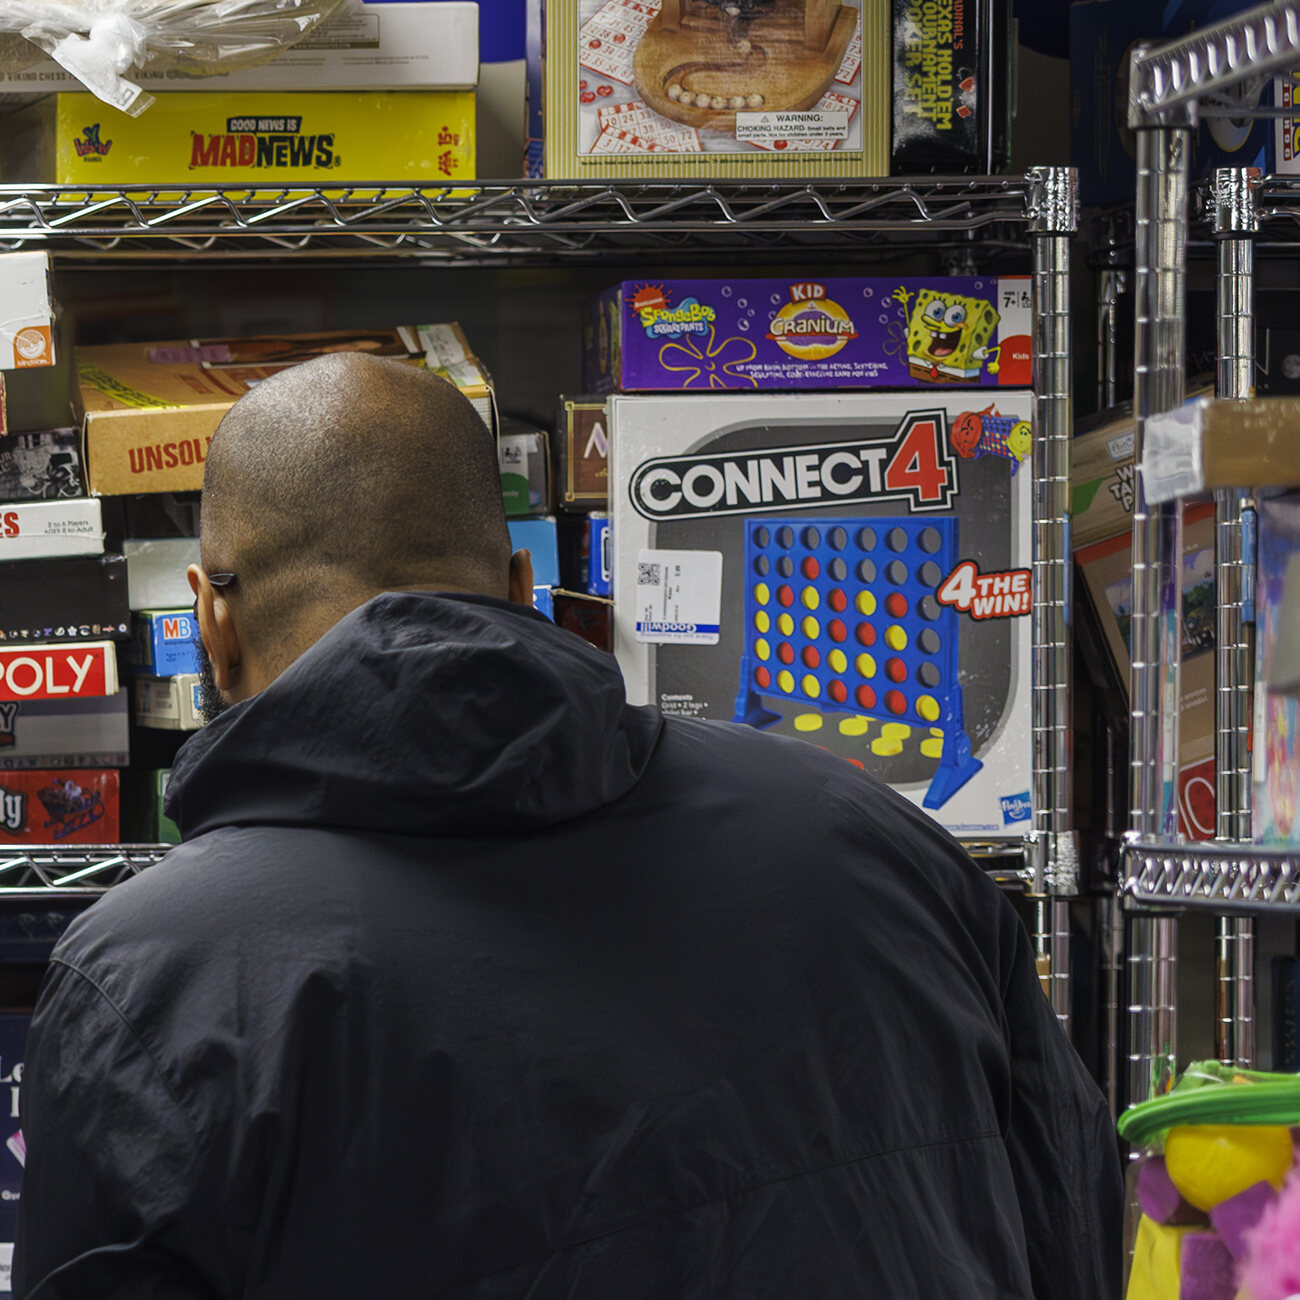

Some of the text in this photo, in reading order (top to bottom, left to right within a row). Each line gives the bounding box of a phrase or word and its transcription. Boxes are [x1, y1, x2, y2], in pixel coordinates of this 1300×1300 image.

[190, 132, 334, 169] MADNEWS
[793, 285, 825, 301] KID
[128, 437, 209, 476] UNSOL
[639, 421, 948, 512] CONNECT 4
[941, 563, 1028, 609] 4 THE
[974, 592, 1031, 615] WIN!
[163, 617, 192, 640] MB
[640, 621, 698, 634] Goodwill
